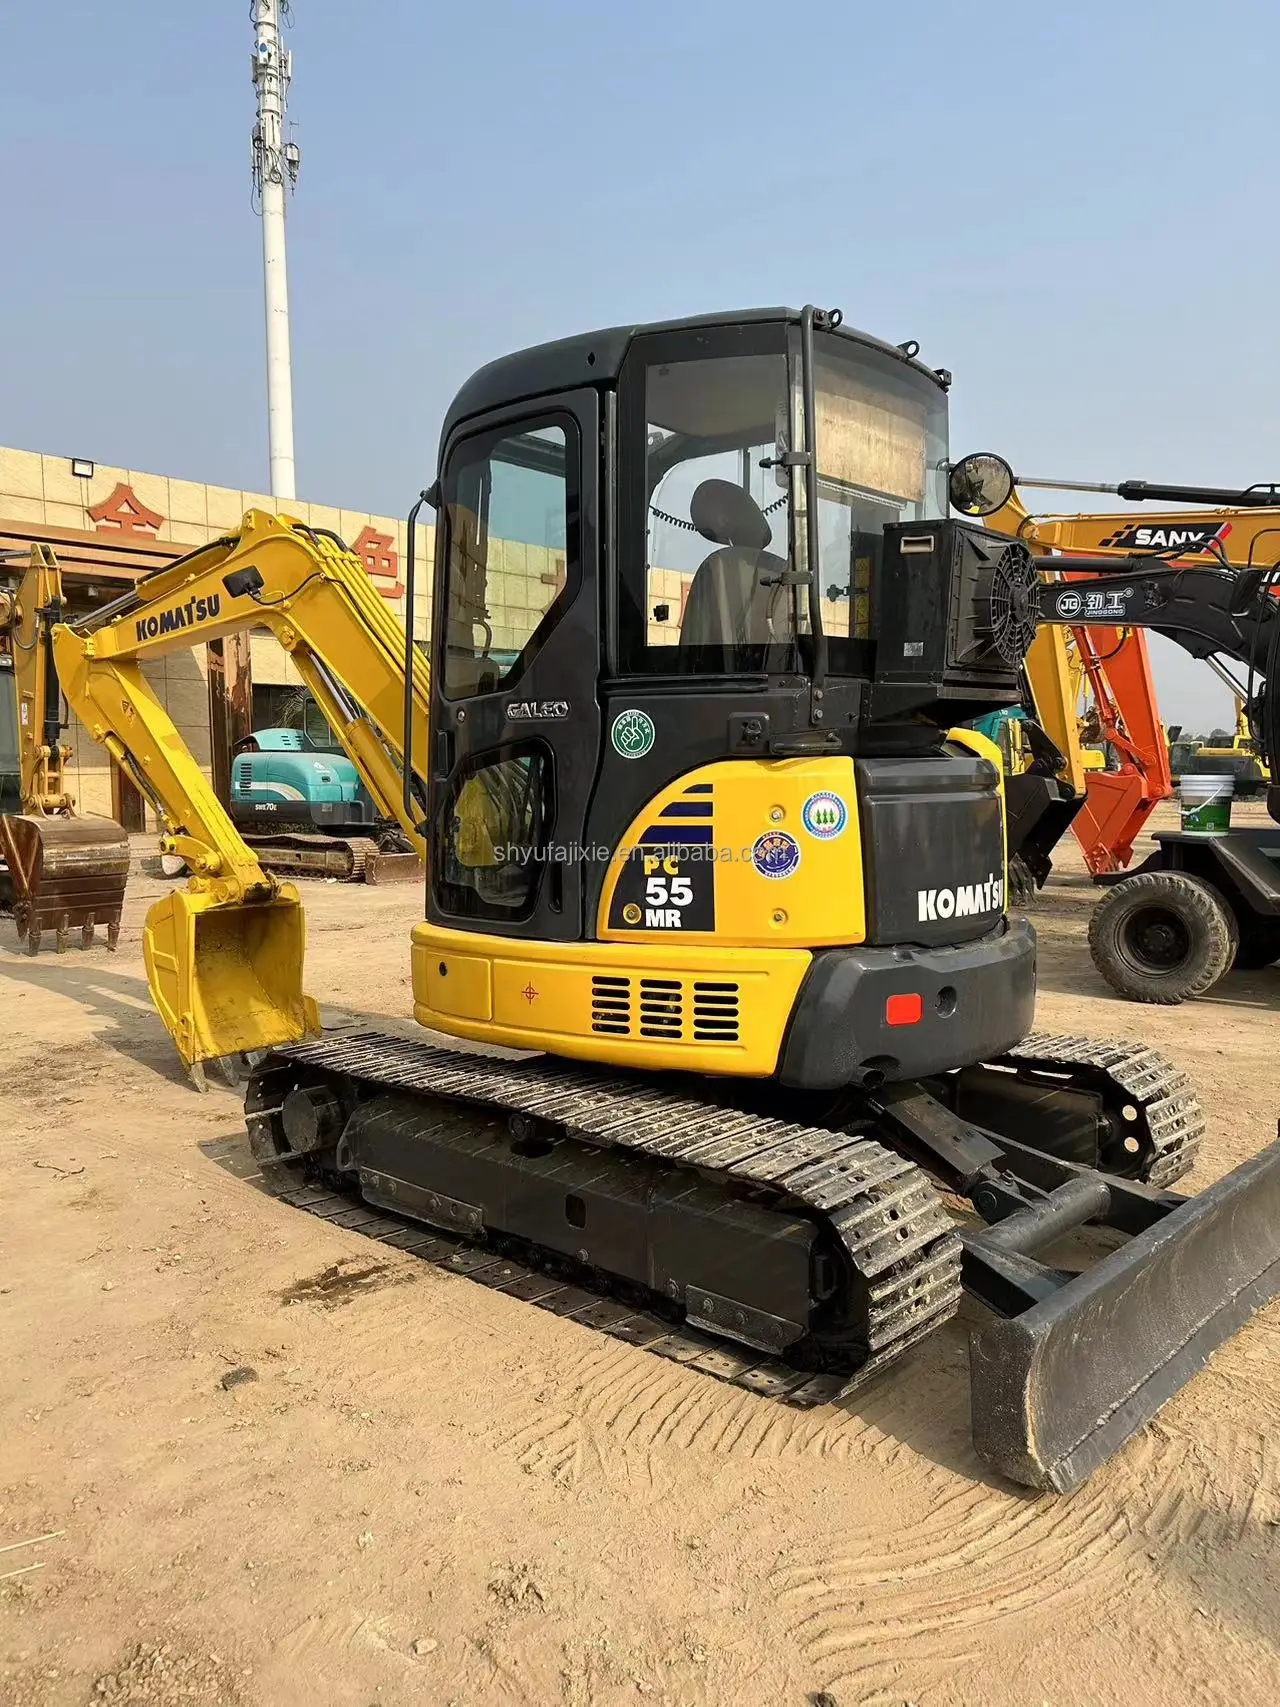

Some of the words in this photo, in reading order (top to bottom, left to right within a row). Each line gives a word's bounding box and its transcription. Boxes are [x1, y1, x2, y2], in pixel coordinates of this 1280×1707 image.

[136, 594, 220, 642] KOMATSU
[506, 701, 569, 719] GALEO
[643, 854, 679, 876] PC
[645, 877, 694, 906] 55
[645, 908, 682, 928] MR
